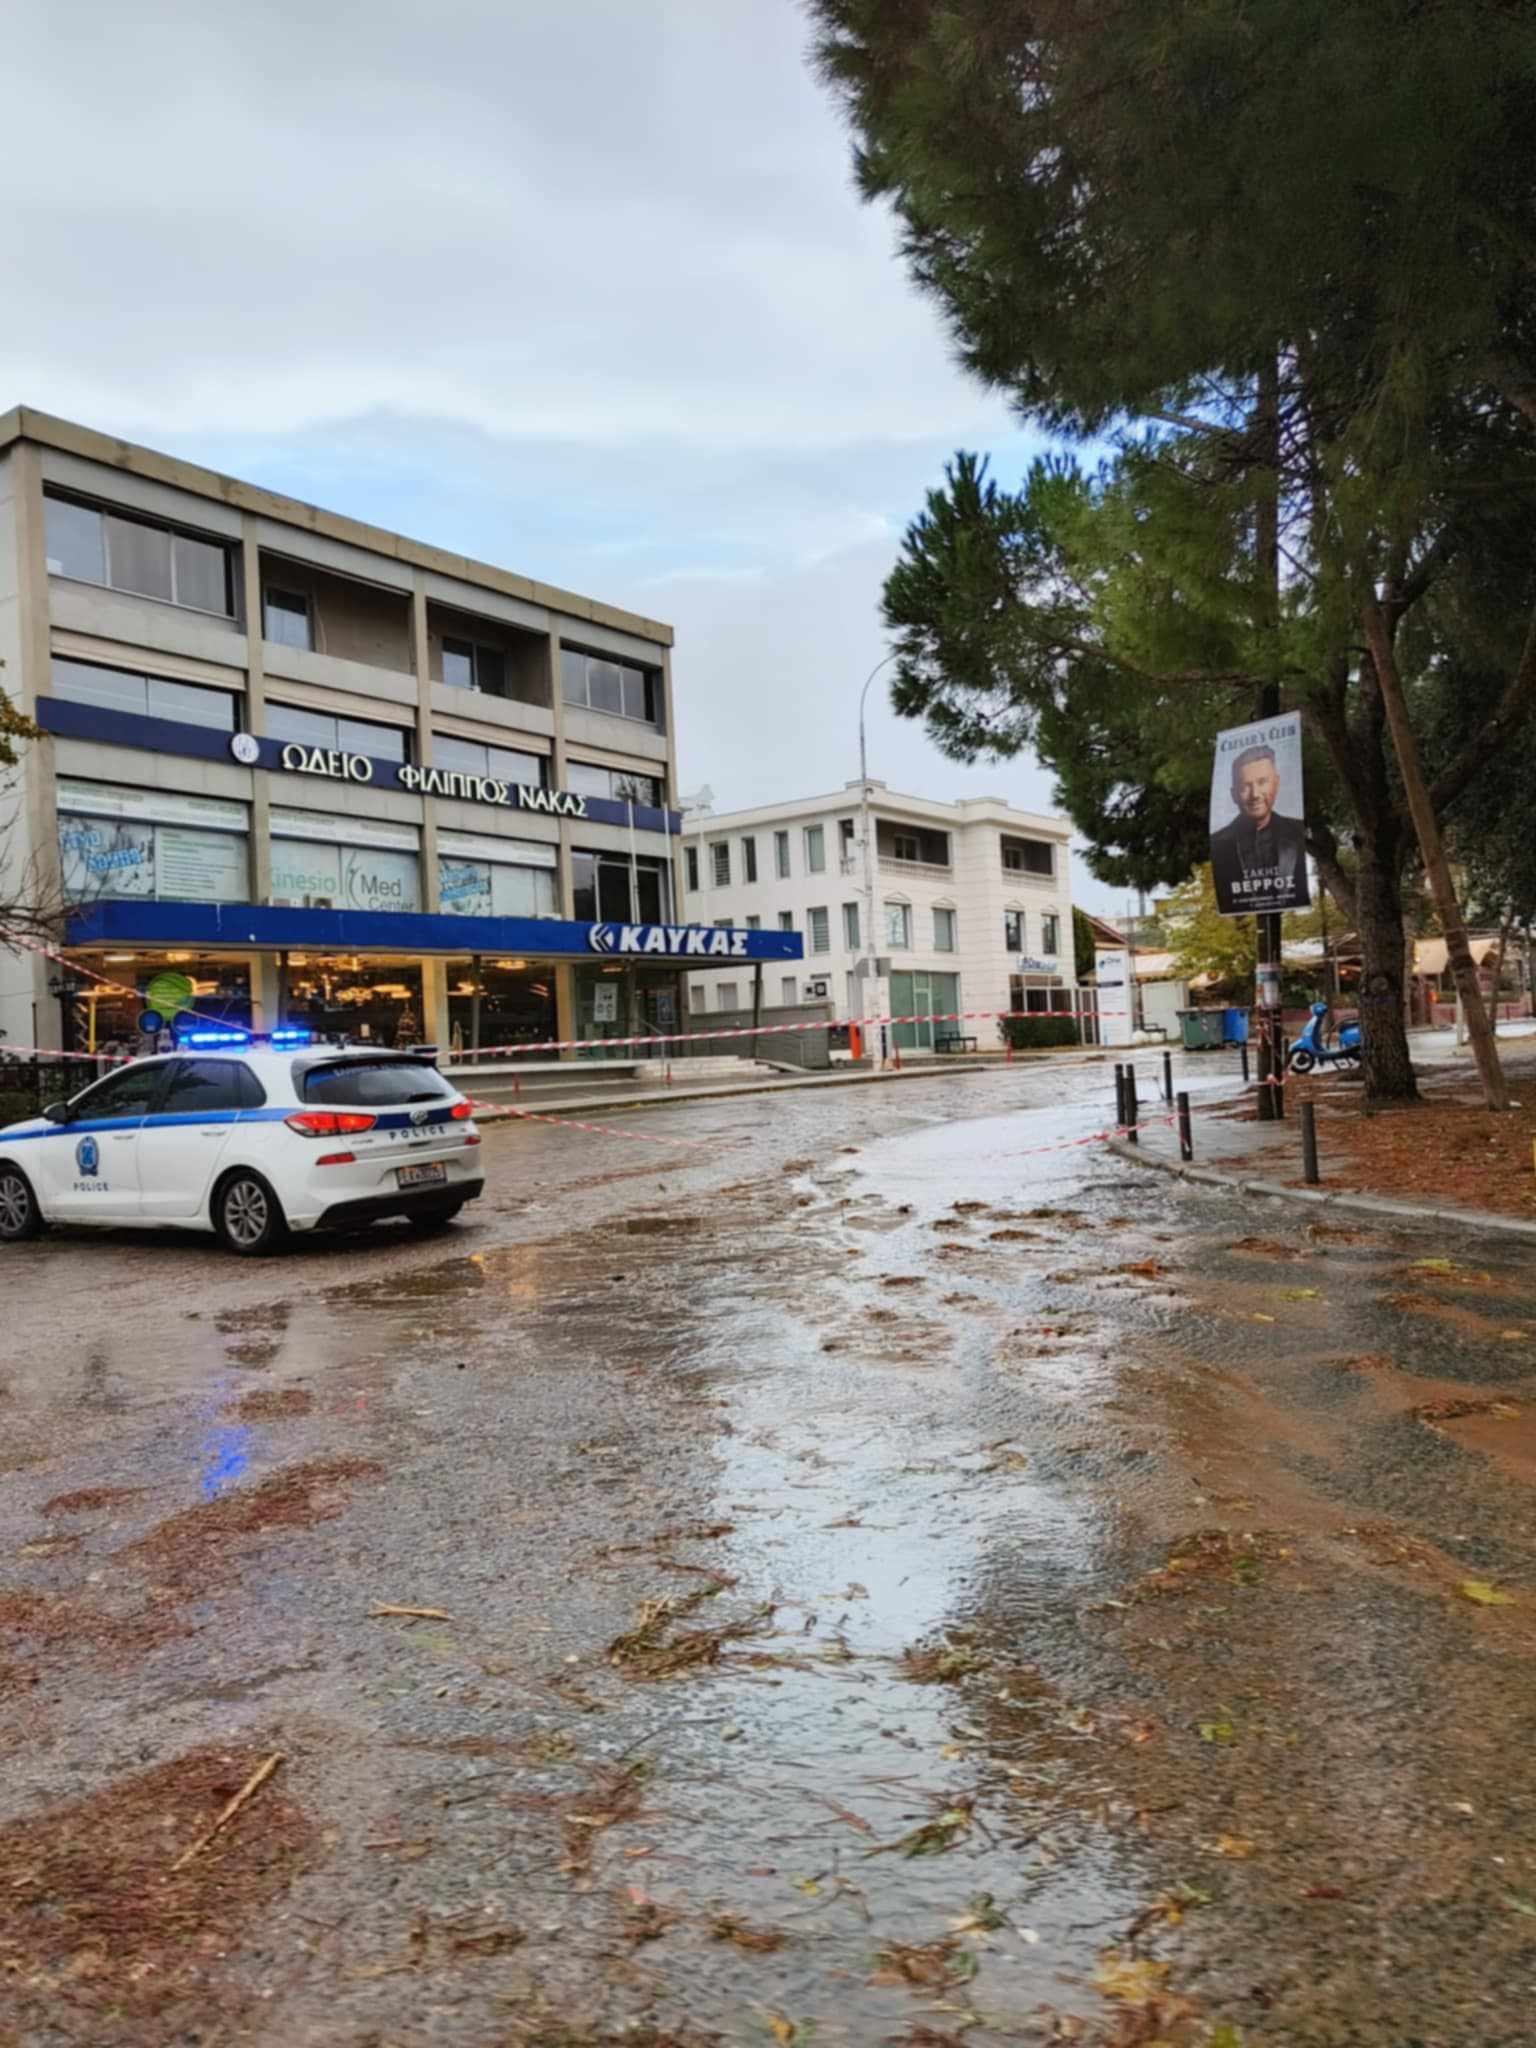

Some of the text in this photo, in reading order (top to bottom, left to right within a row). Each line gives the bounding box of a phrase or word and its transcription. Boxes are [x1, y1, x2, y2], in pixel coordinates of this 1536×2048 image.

[281, 743, 589, 818] ΩΔΕΙΟ ΦΙΛΙΠΠΟΣ ΝΑΚΑΣ
[361, 874, 402, 897] Med
[1231, 875, 1296, 894] ΒΕΡΡΟΣ
[619, 926, 749, 957] ΚΑΥΚΑΣ
[389, 1125, 447, 1141] POLICE
[73, 1182, 110, 1192] POLICE
